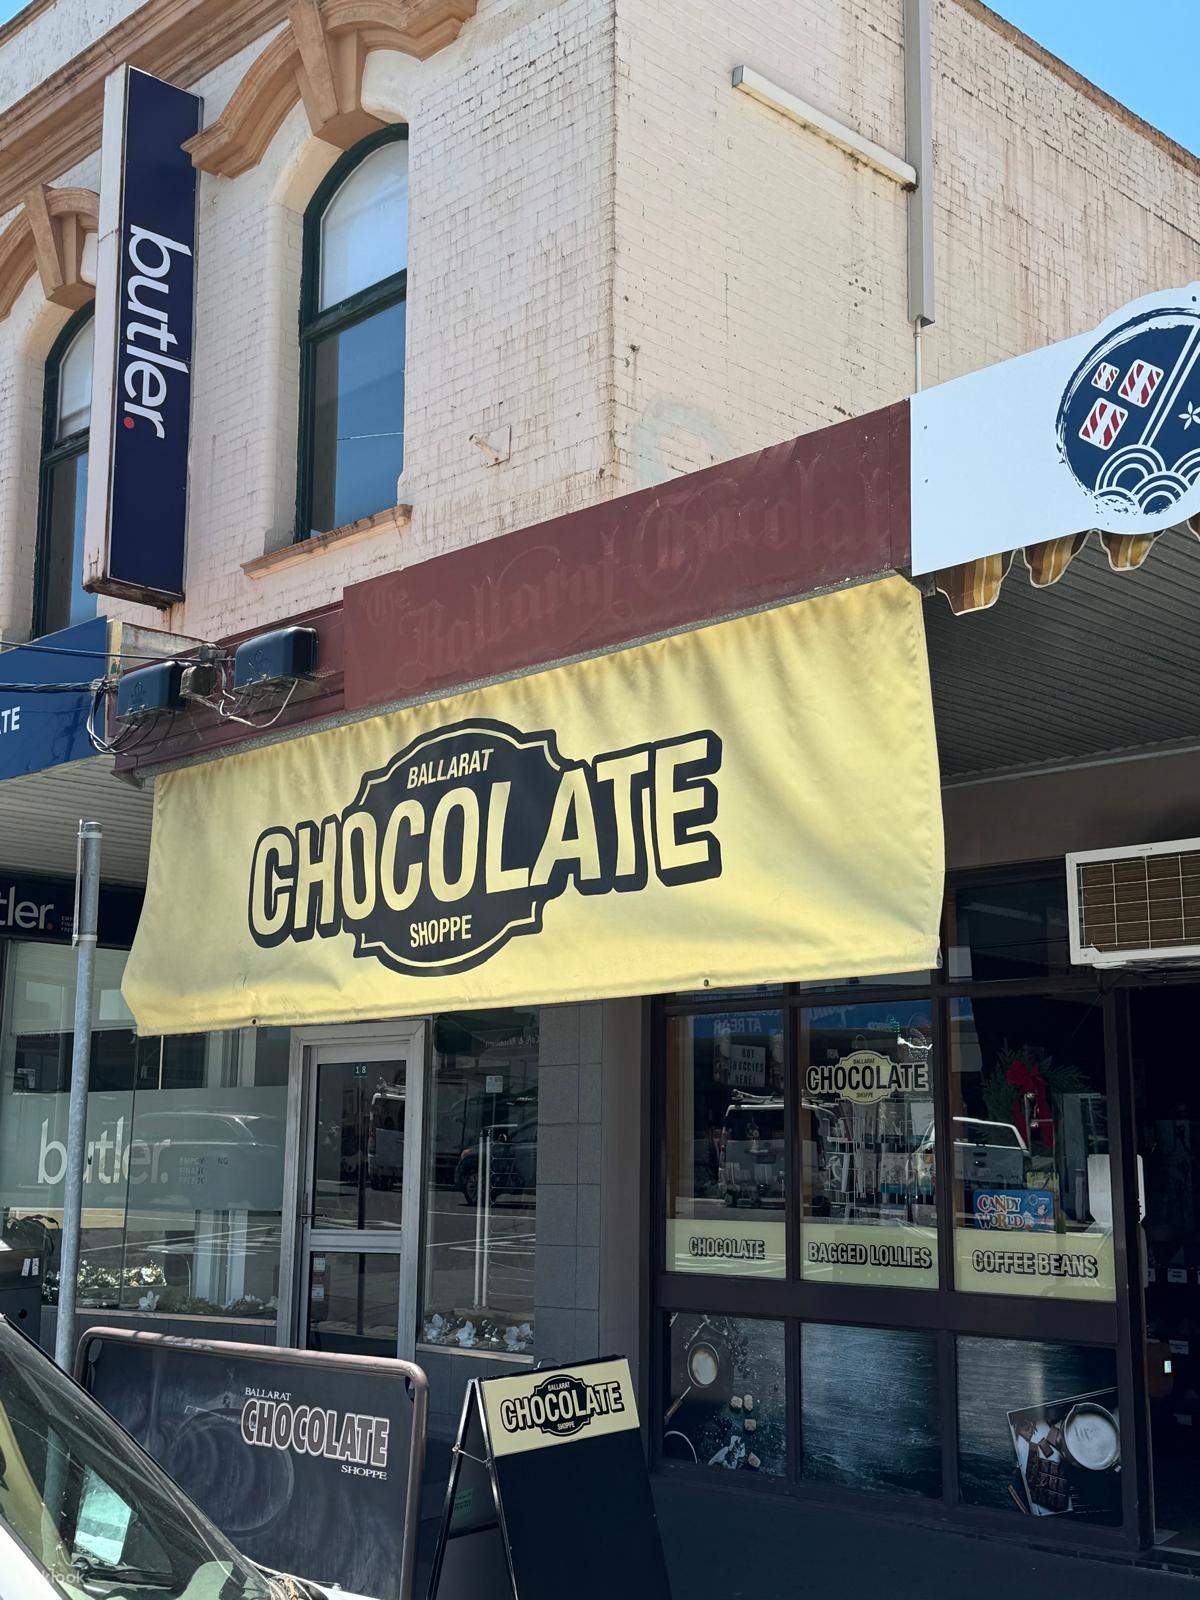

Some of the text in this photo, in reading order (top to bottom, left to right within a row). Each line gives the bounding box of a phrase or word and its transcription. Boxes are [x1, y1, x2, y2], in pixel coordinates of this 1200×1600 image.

[124, 224, 193, 439] butler.
[0, 706, 21, 735] TE
[406, 748, 495, 790] BALLARAT
[249, 731, 721, 947] CHOCOLATE
[409, 914, 473, 949] SHOPPE
[355, 1066, 367, 1074] 18
[806, 1062, 928, 1094] CHOCOLATE
[977, 1195, 1021, 1214] CANDY
[975, 1213, 1025, 1229] WORLD
[689, 1237, 765, 1259] CHOCOLATE
[808, 1241, 932, 1269] BAGGED LOLLIES
[972, 1249, 1099, 1278] COFFEE BEANS
[245, 1387, 292, 1401] BALLARAT
[501, 1381, 624, 1433] CHOCOLATE
[241, 1398, 390, 1468] CHOCOLATE
[340, 1464, 388, 1481] SHOPPE
